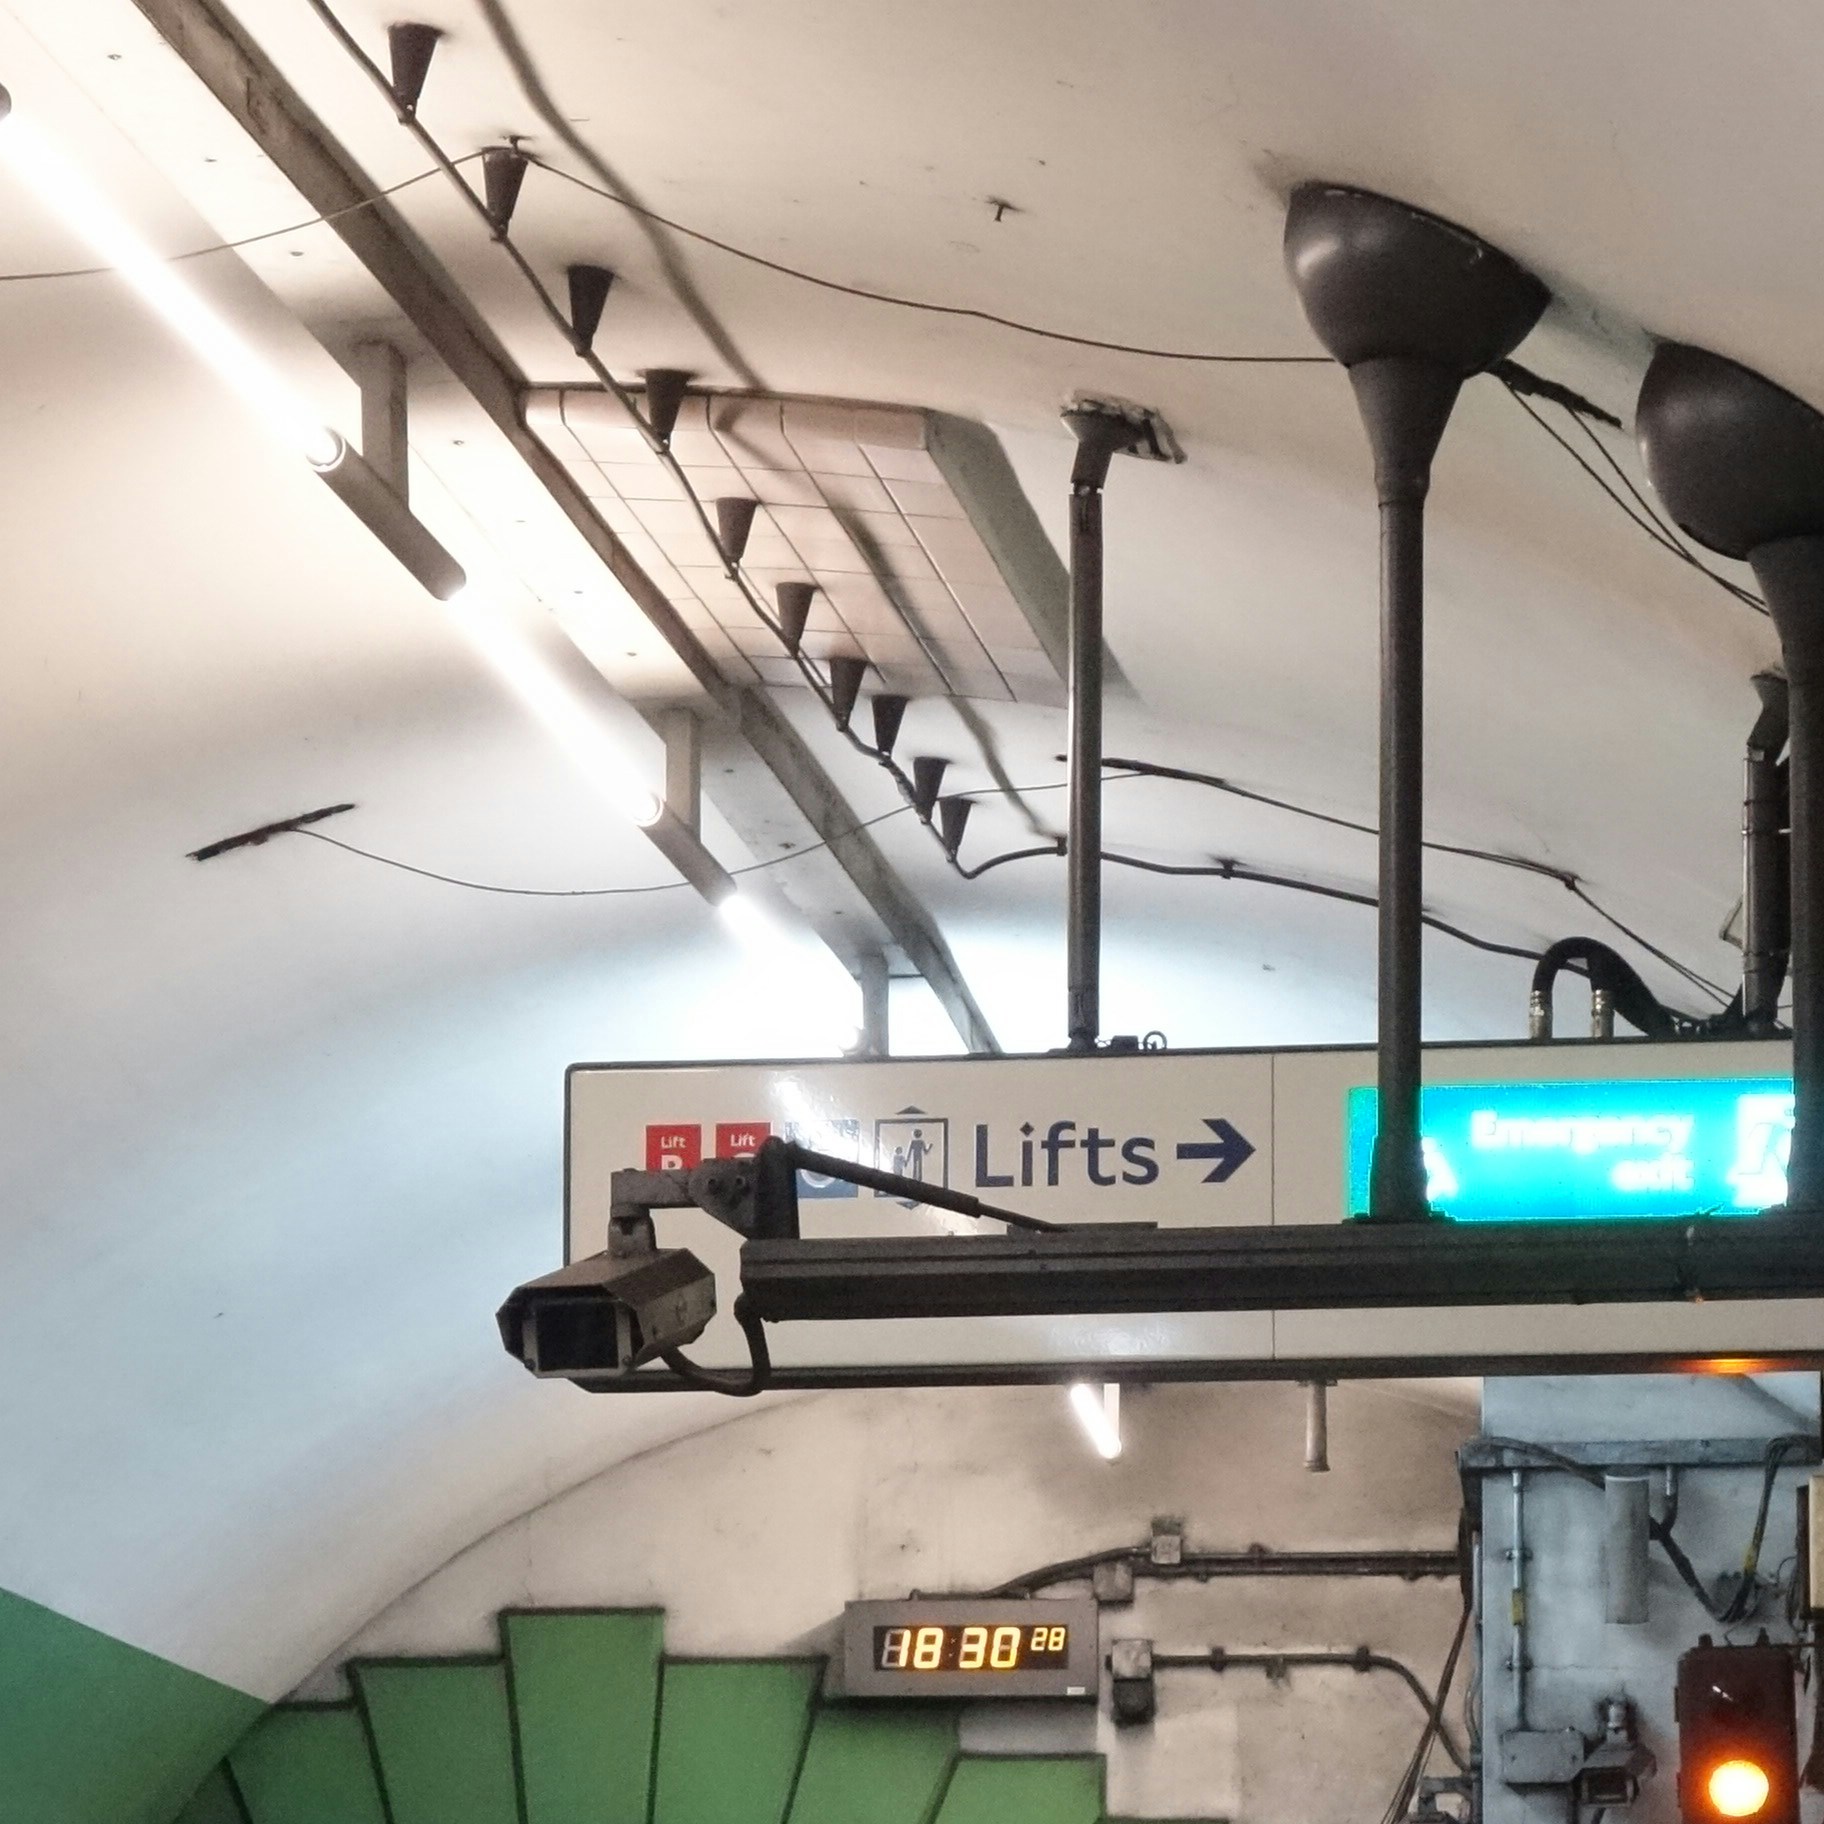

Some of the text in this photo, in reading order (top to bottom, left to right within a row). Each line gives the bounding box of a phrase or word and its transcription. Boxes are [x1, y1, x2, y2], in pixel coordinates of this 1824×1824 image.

[661, 1132, 755, 1149] Lift Lift
[977, 1120, 1159, 1187] Lifts
[1031, 1627, 1066, 1650] 28
